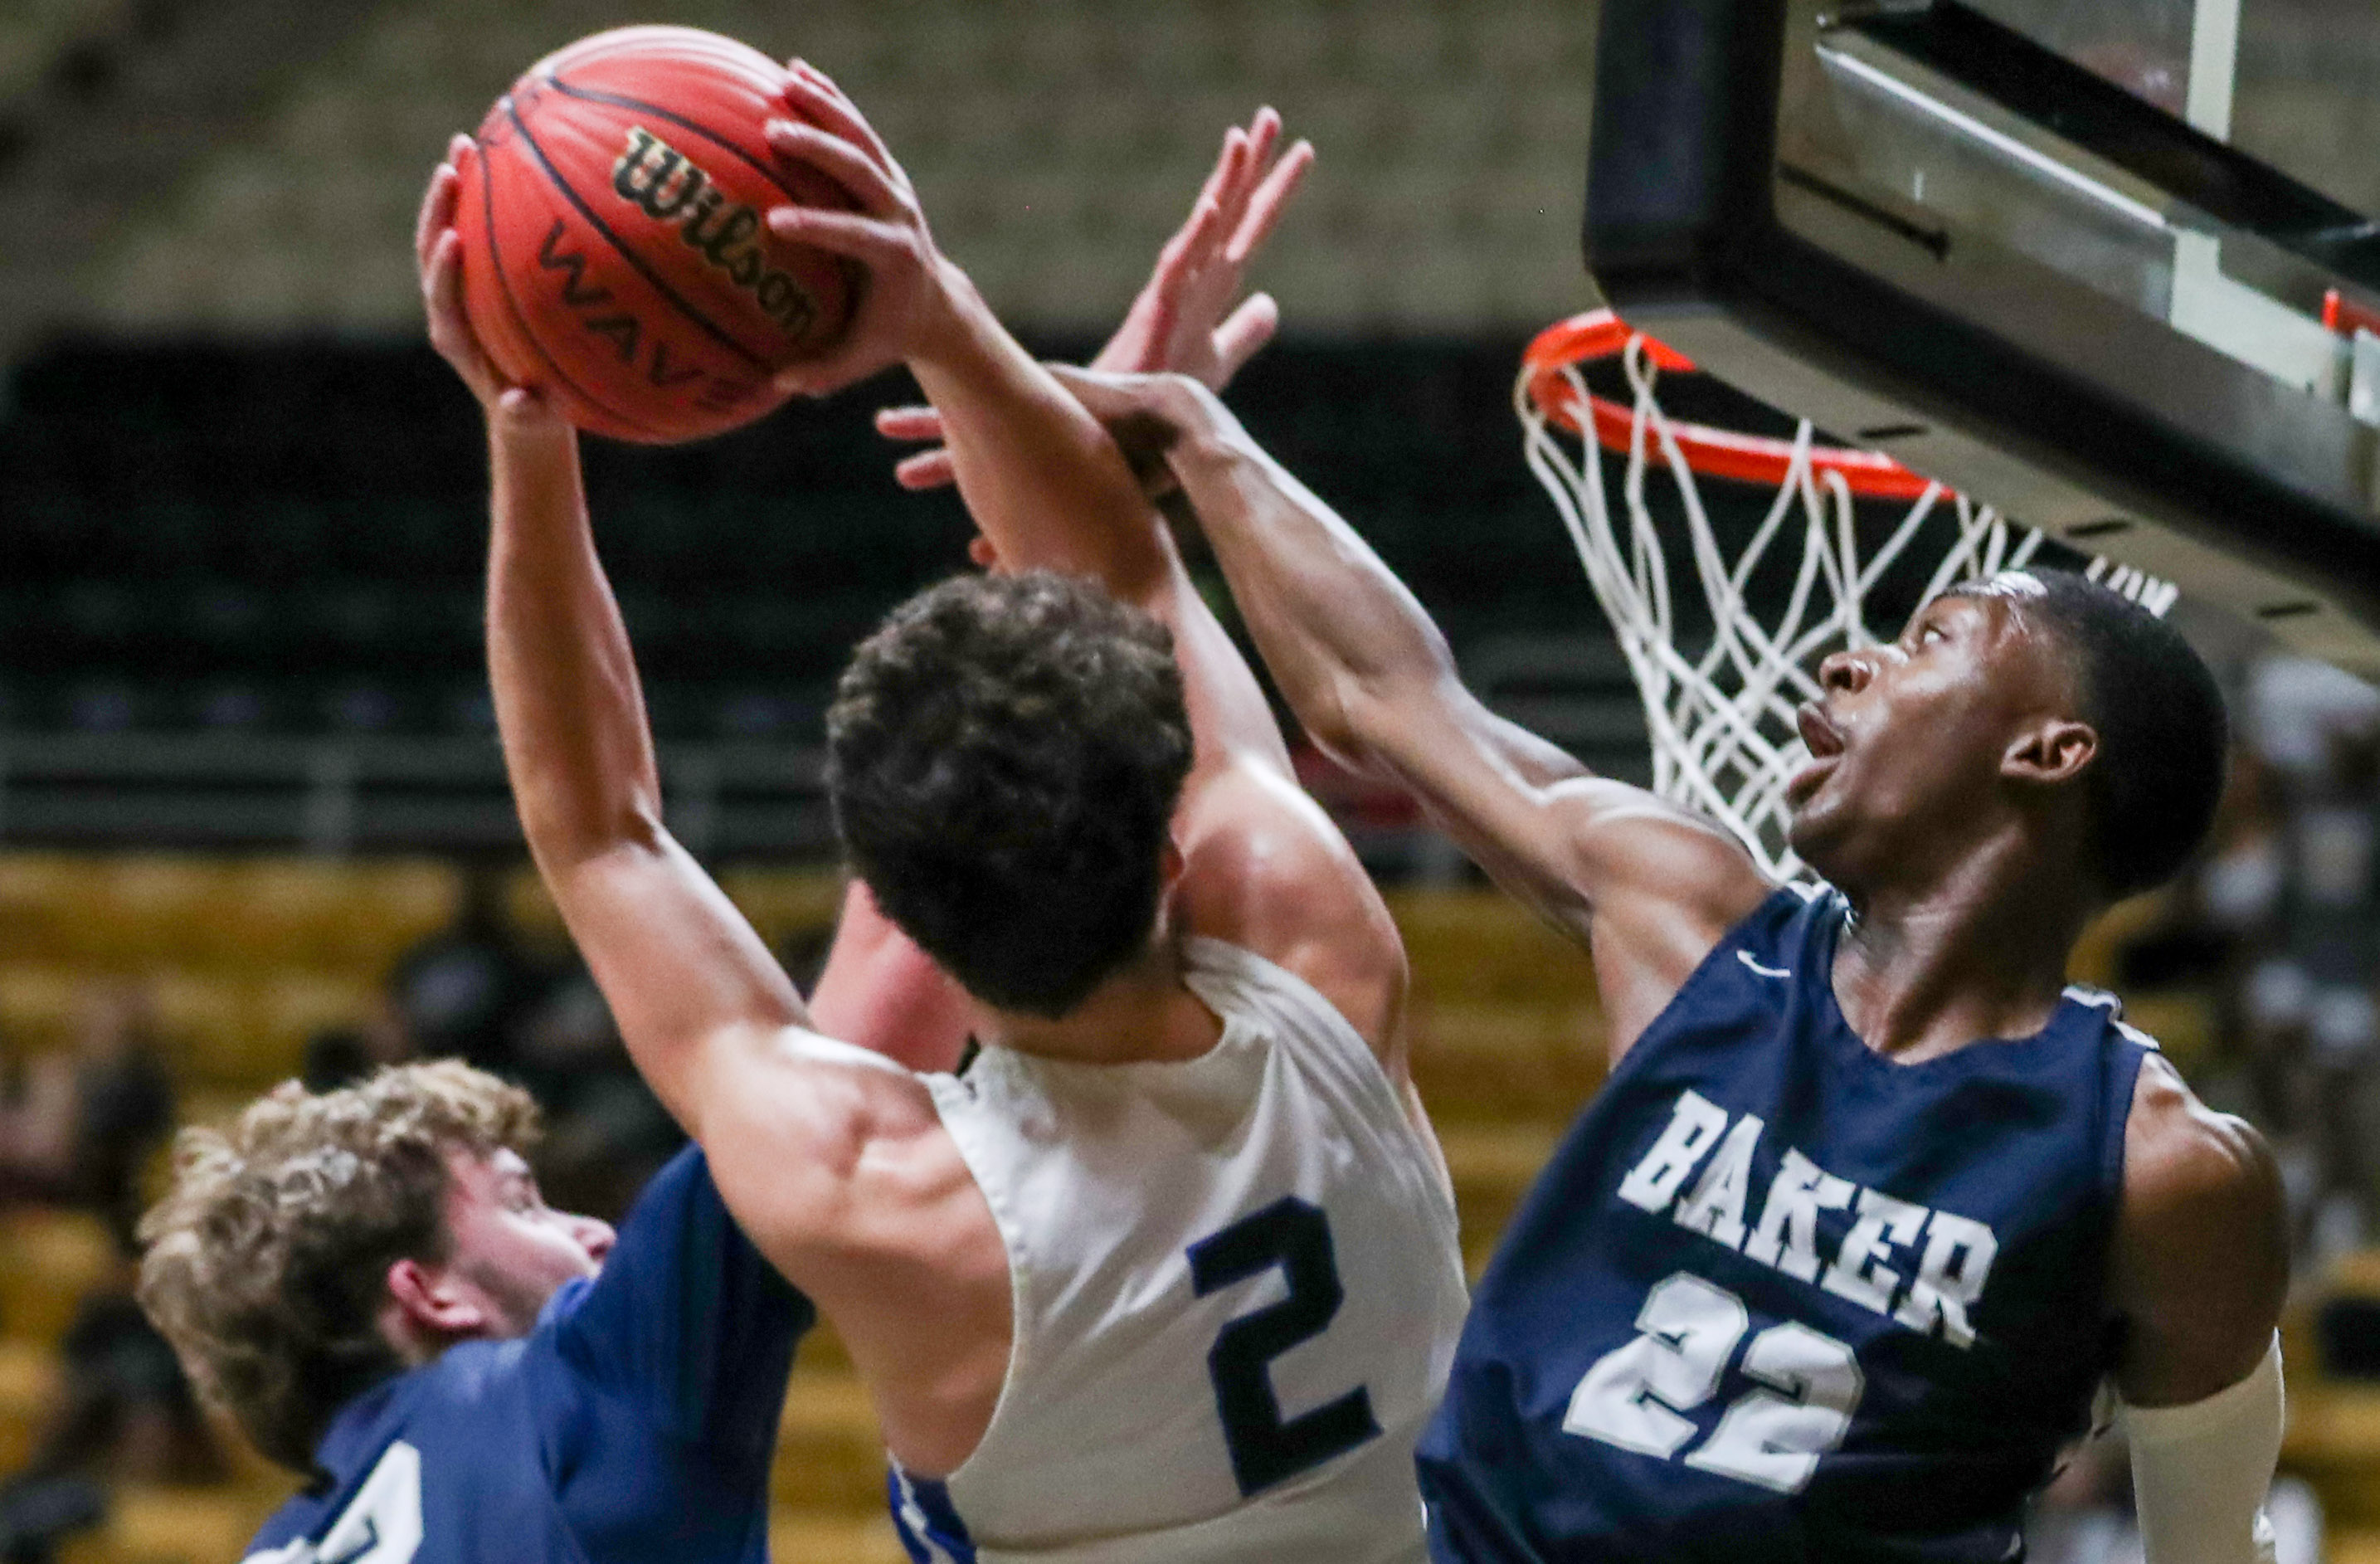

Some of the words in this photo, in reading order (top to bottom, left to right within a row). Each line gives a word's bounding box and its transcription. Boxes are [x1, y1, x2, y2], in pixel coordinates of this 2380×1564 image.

[614, 126, 816, 333] Wilson
[1617, 1089, 1998, 1350] BAKER
[1186, 1196, 1384, 1498] 2
[1562, 1270, 1865, 1494] 22
